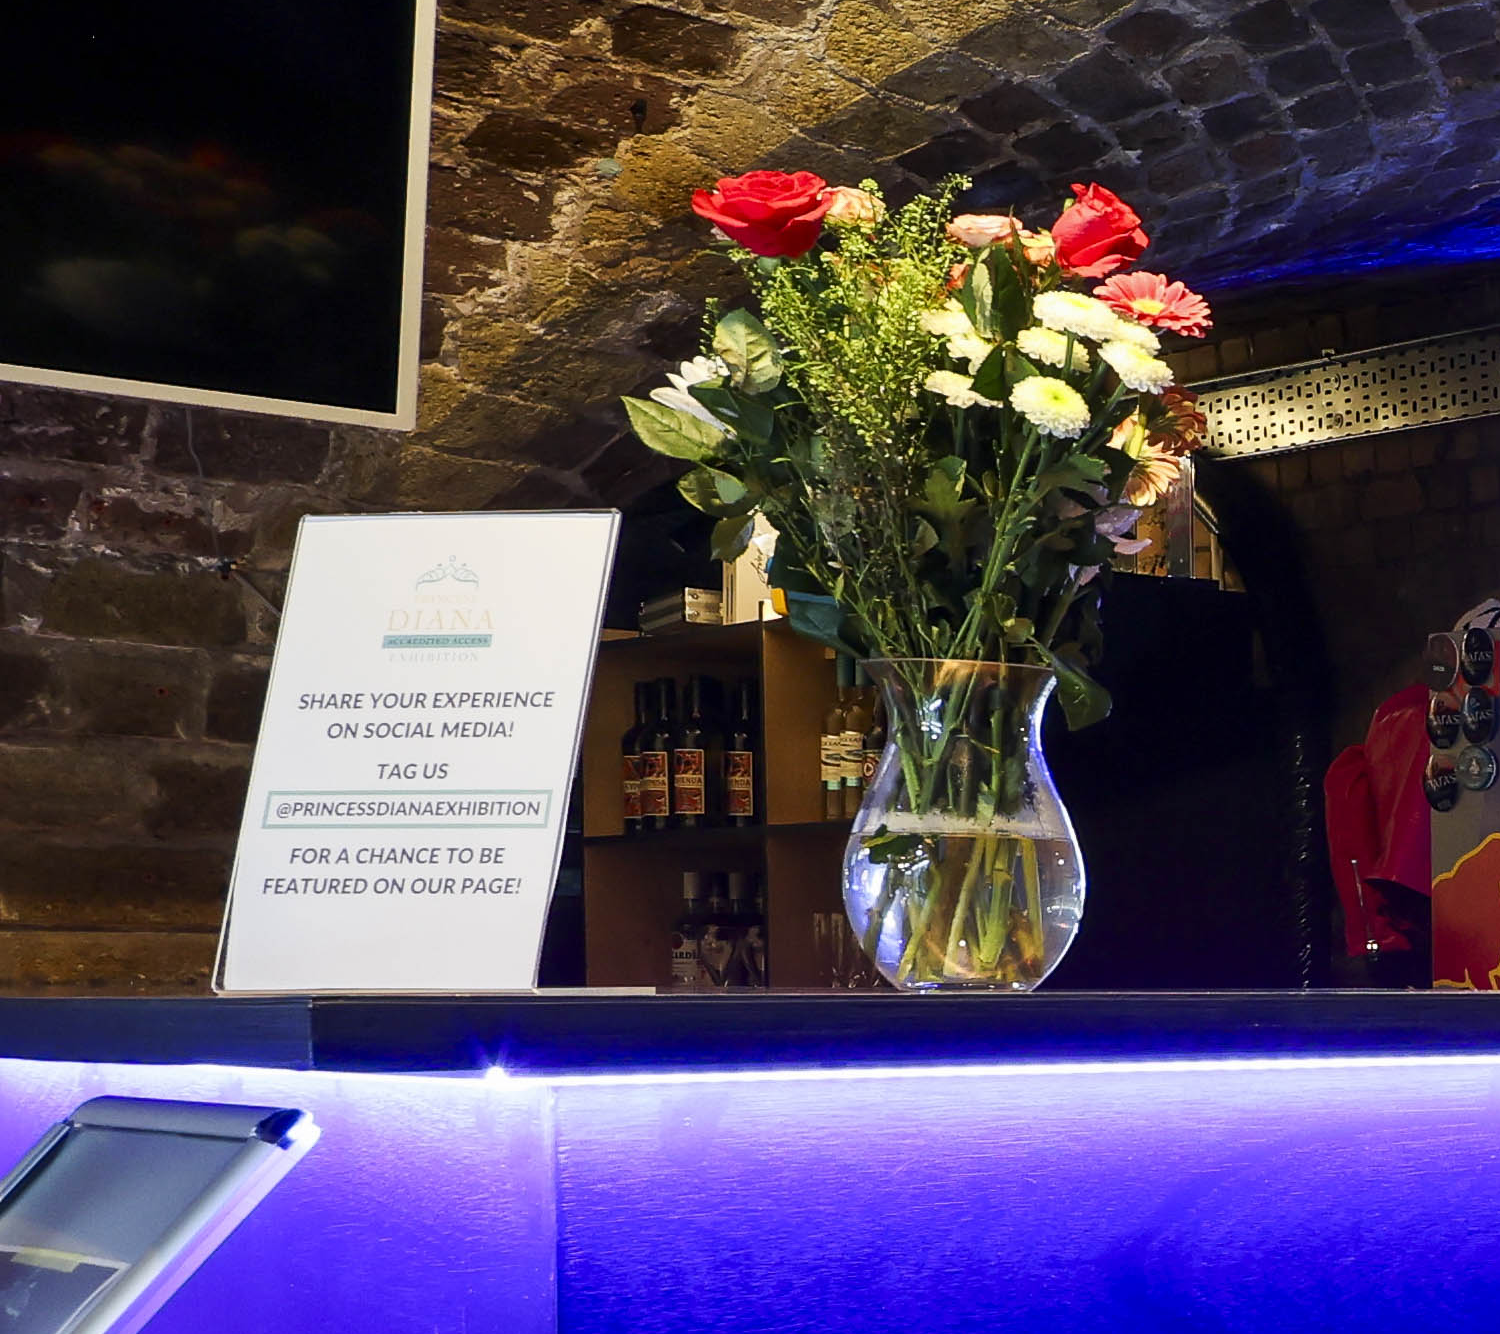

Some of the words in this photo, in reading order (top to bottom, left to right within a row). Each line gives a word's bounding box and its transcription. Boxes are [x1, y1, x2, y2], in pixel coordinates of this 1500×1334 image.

[387, 609, 496, 630] DIANA
[298, 693, 365, 710] SHARE
[371, 692, 427, 709] YOUR
[433, 691, 555, 709] EXPERIENCE
[327, 723, 359, 739] ON
[363, 722, 435, 739] SOCIAL
[441, 721, 514, 738] MEDIA!
[377, 763, 417, 780] TAG
[423, 763, 449, 779] US
[276, 801, 541, 819] @PRINCESSDIANAEXHIBITION
[289, 848, 331, 865] FOR
[335, 848, 350, 865] A
[355, 848, 441, 865] CHANCE
[447, 847, 474, 865] TO
[479, 847, 506, 864] BE
[262, 878, 369, 895] FEATURED
[374, 878, 406, 895] ON
[410, 878, 456, 895] OUR
[460, 877, 522, 895] PAGE!
